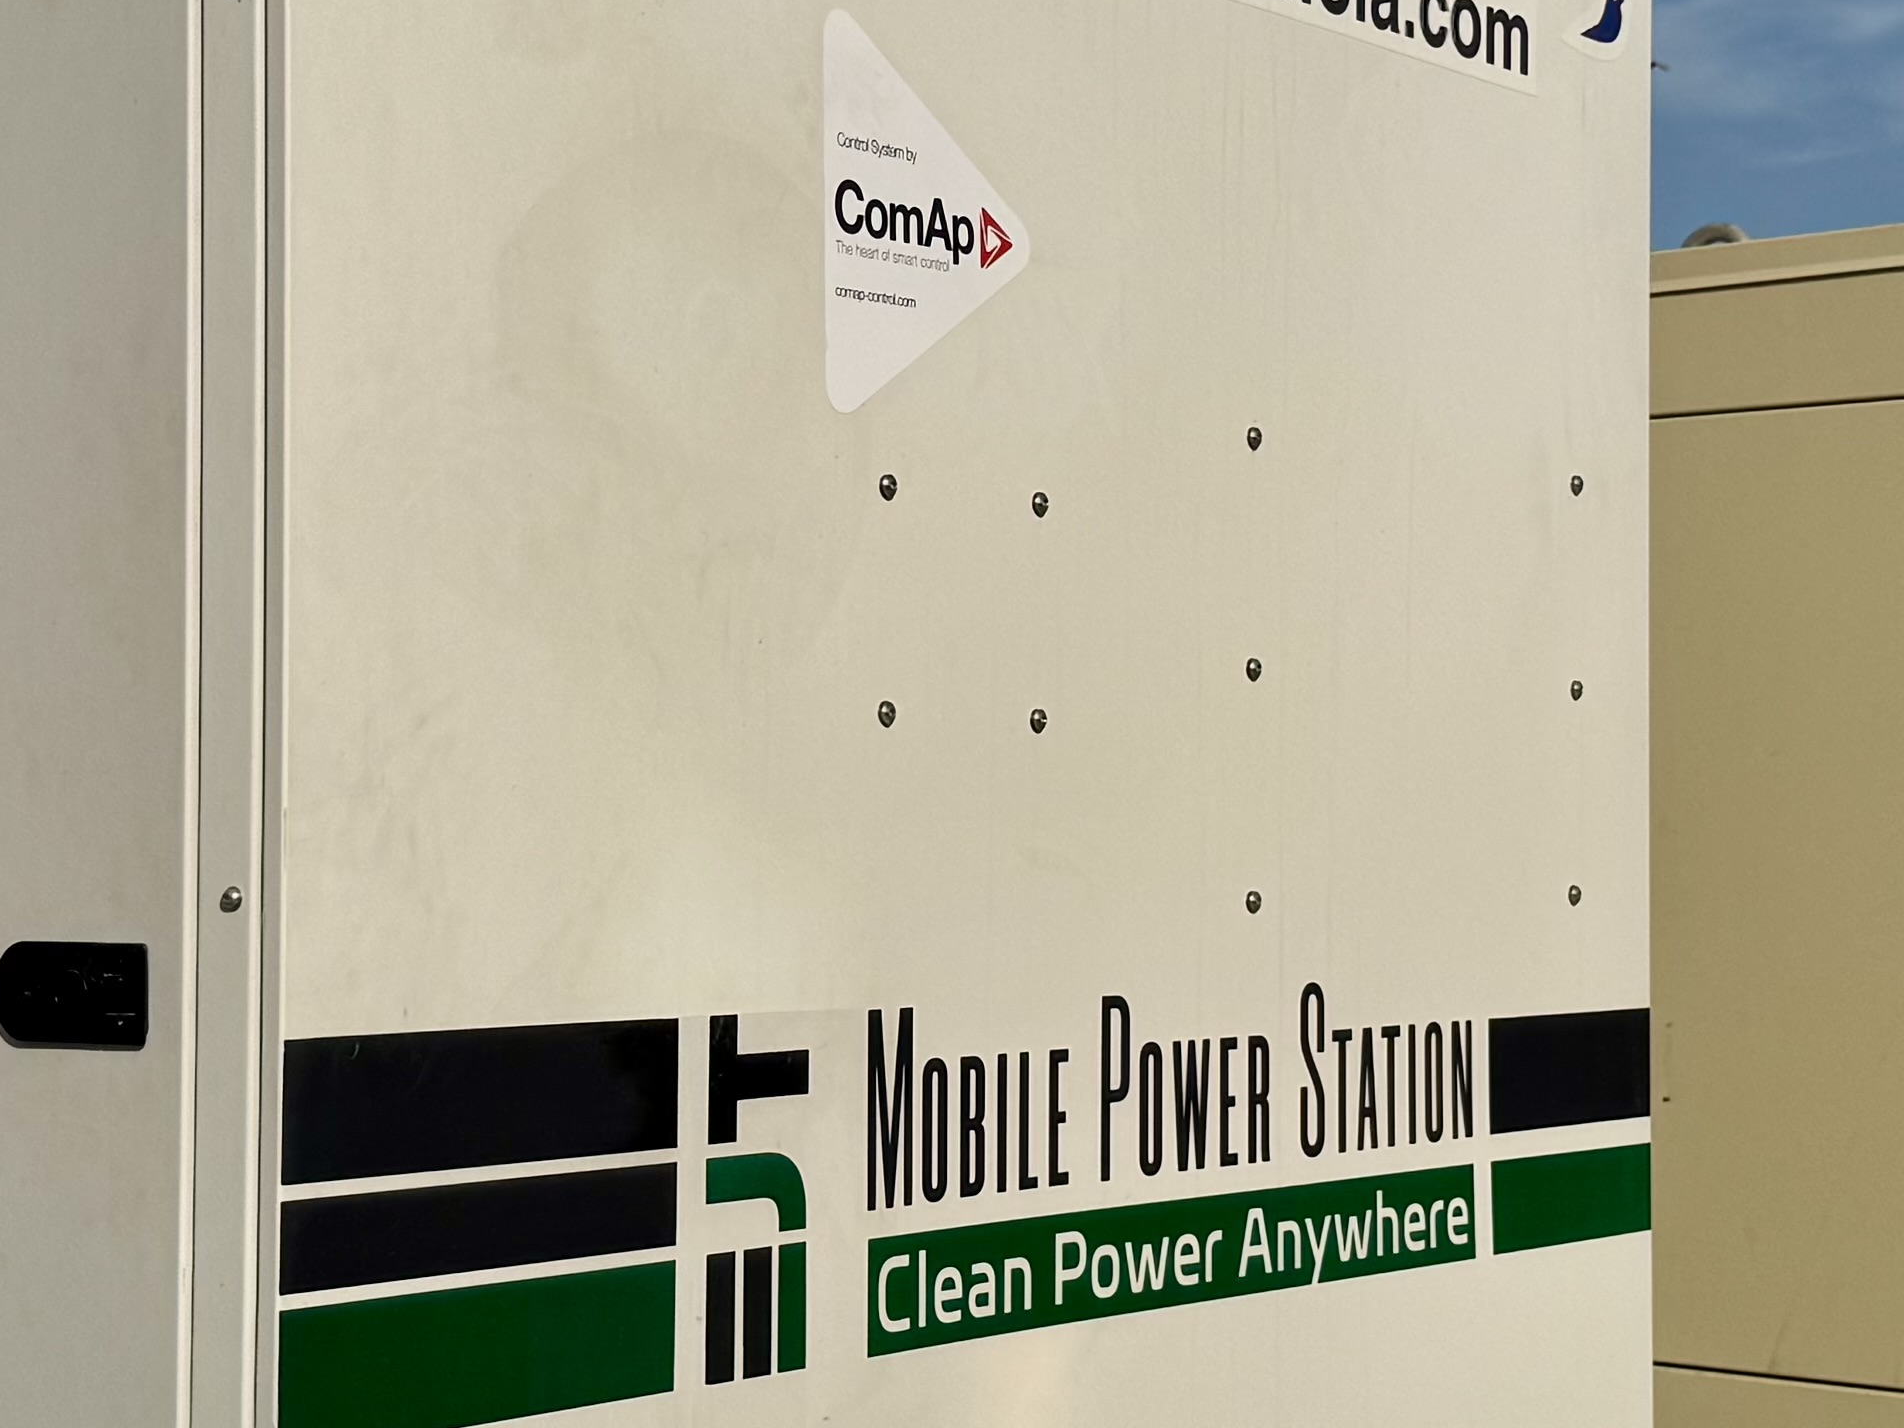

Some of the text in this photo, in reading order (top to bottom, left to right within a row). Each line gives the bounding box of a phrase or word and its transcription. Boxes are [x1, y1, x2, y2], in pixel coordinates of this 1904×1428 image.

[837, 132, 917, 165] Control System by
[835, 179, 974, 265] ComAp
[836, 240, 950, 272] The heart of smart control
[835, 287, 917, 308] comap-control.com
[867, 982, 1473, 1211] MOBILE POWER STATION
[878, 1190, 1469, 1333] Clean Power Anywhere
